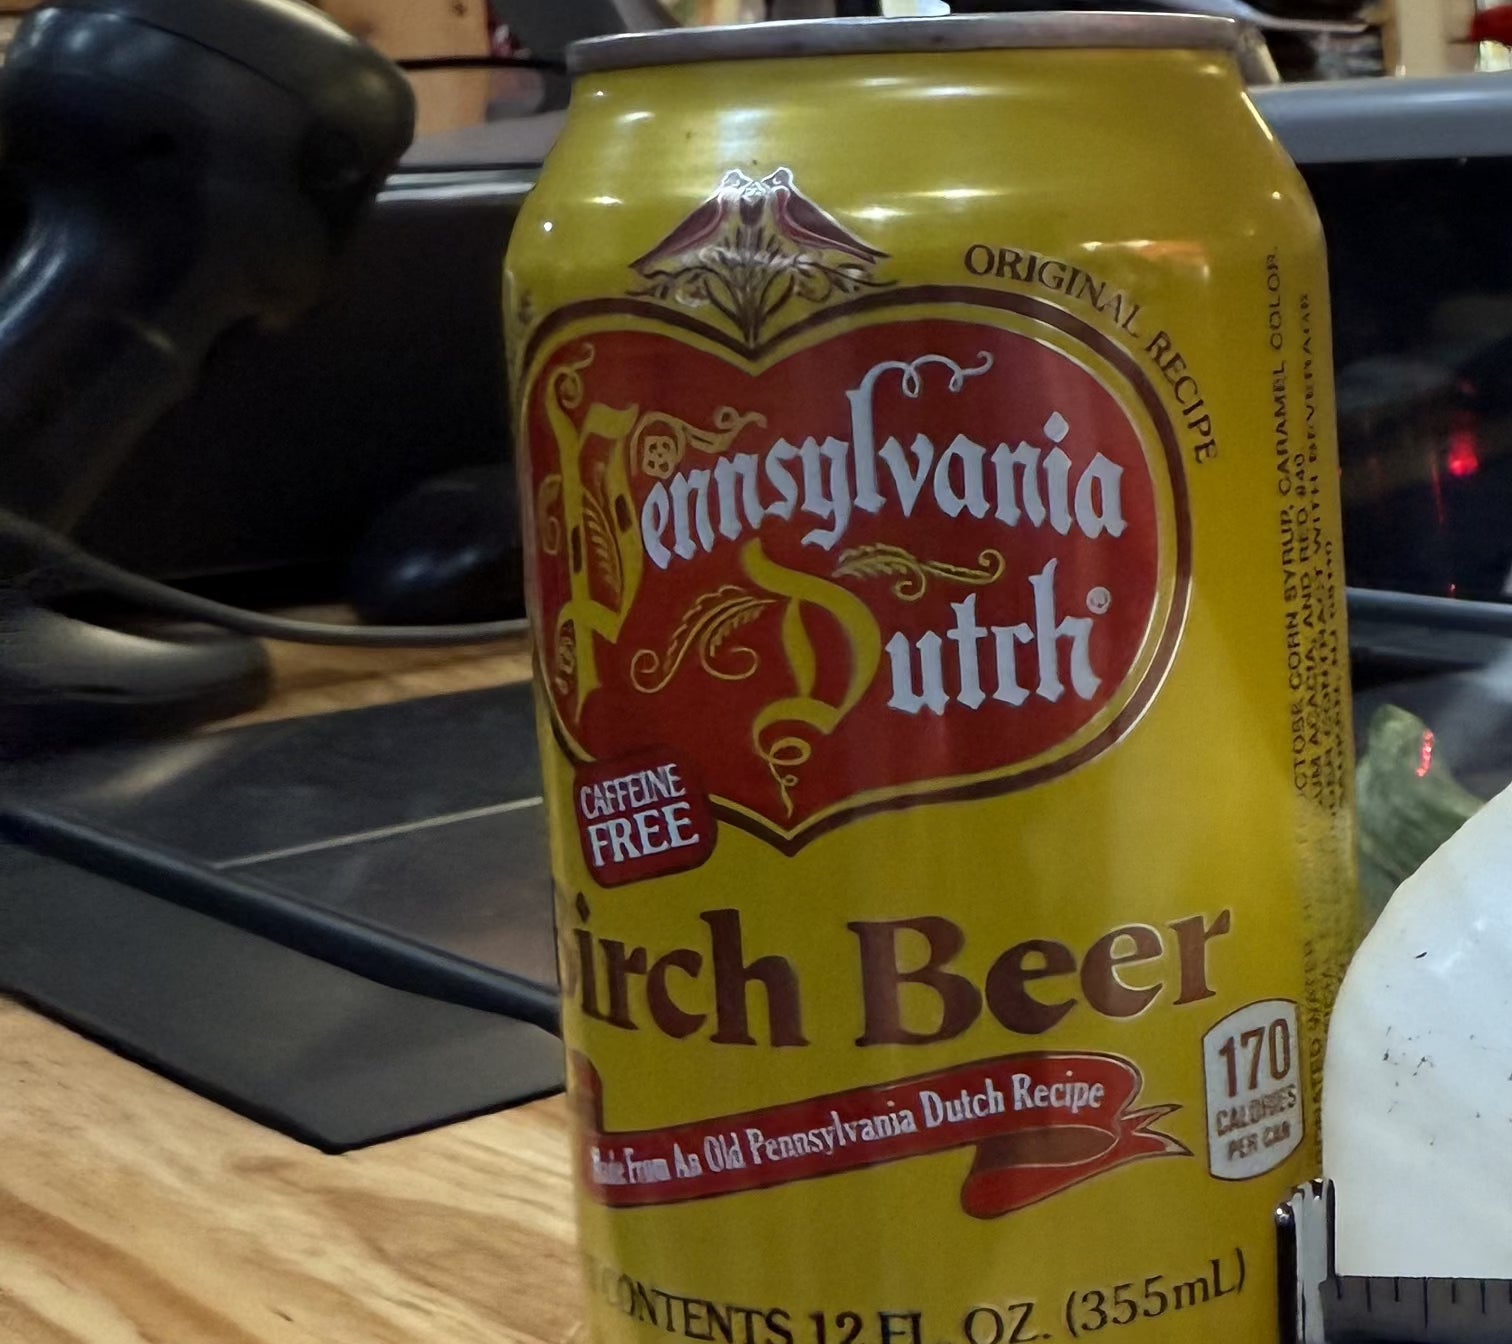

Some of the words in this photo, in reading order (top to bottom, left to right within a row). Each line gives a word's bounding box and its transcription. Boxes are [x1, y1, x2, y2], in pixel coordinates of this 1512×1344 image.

[964, 243, 1142, 340] ORIGINAL
[1145, 330, 1218, 464] RECIPE
[541, 346, 1129, 724] Pennsylvania
[580, 763, 687, 820] CAFFEINE
[587, 801, 700, 867] FREE
[567, 891, 810, 1048] irch
[847, 909, 1231, 1048] Beer
[1218, 1018, 1291, 1098] 170
[673, 1142, 703, 1179] An
[703, 1131, 746, 1173] Old
[746, 1099, 918, 1165] Pennsylvania
[919, 1077, 1005, 1129] Dutch
[1011, 1069, 1106, 1114] Recipe
[1064, 1247, 1247, 1338] (355mL)
